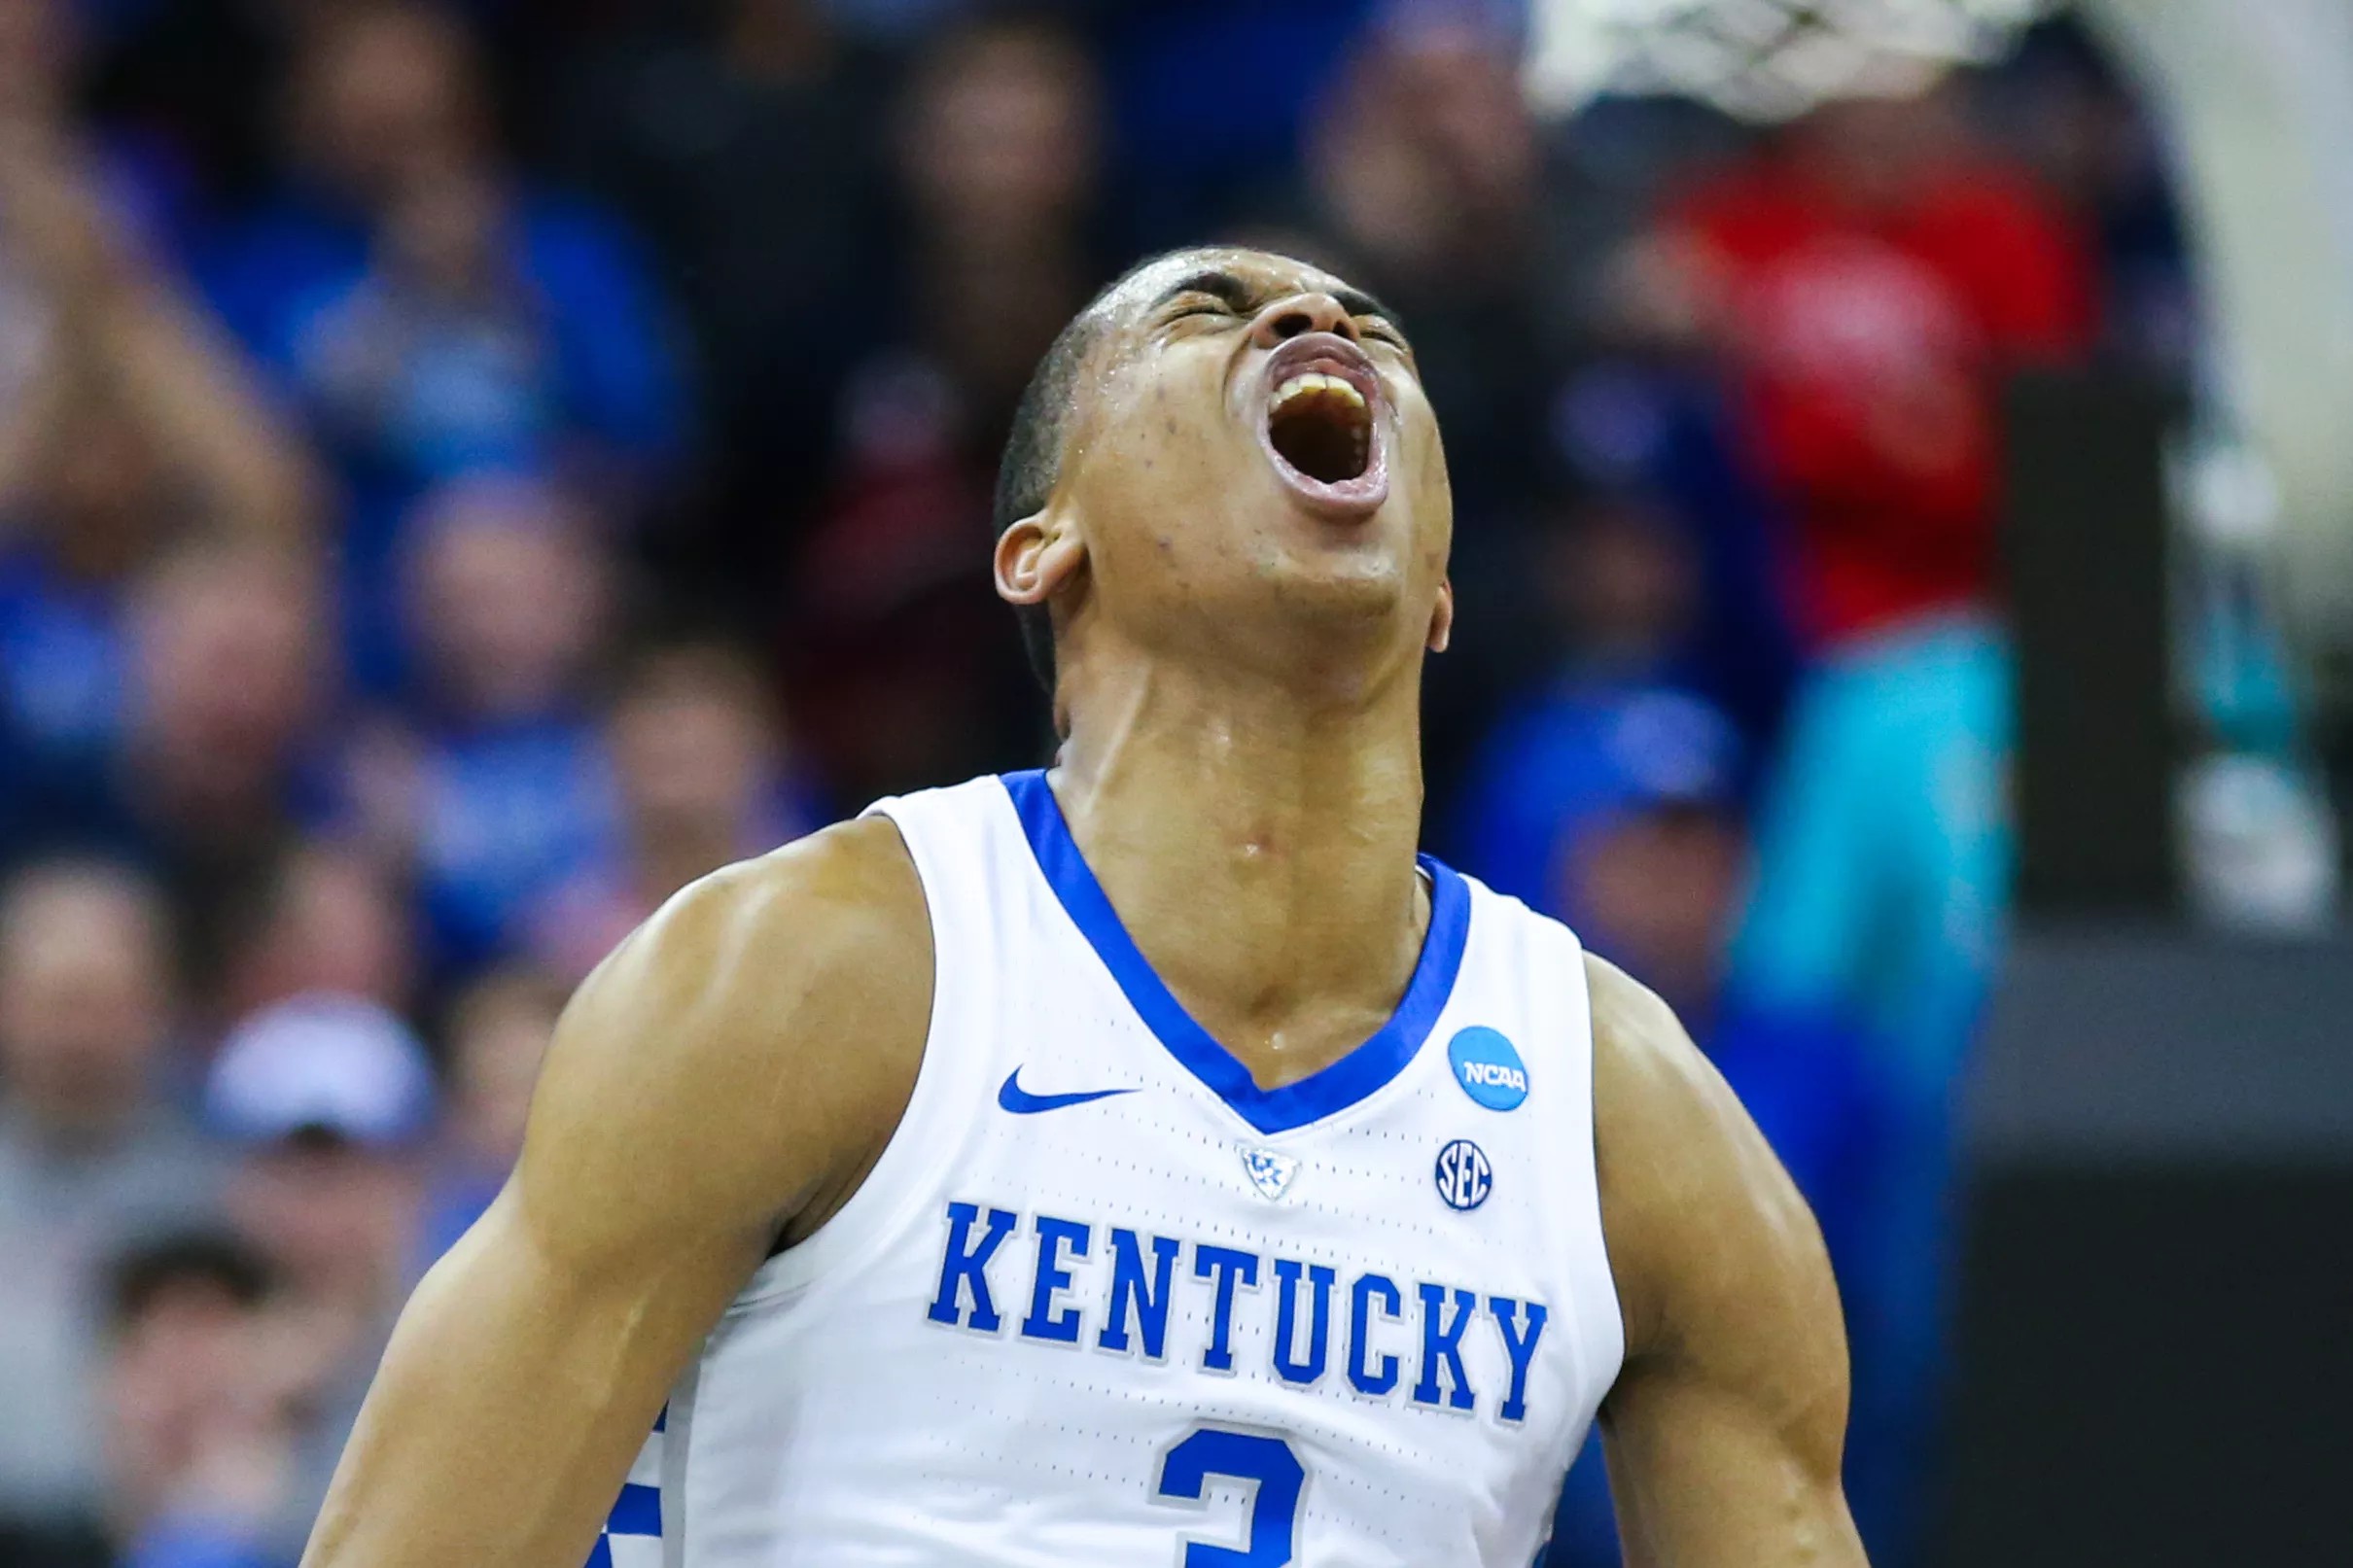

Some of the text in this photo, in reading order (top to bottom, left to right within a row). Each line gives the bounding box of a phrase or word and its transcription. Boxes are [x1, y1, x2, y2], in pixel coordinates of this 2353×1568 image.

[1463, 1061, 1528, 1092] NCAA
[1438, 1141, 1491, 1207] SEC
[926, 1200, 1550, 1424] KENTUCKY
